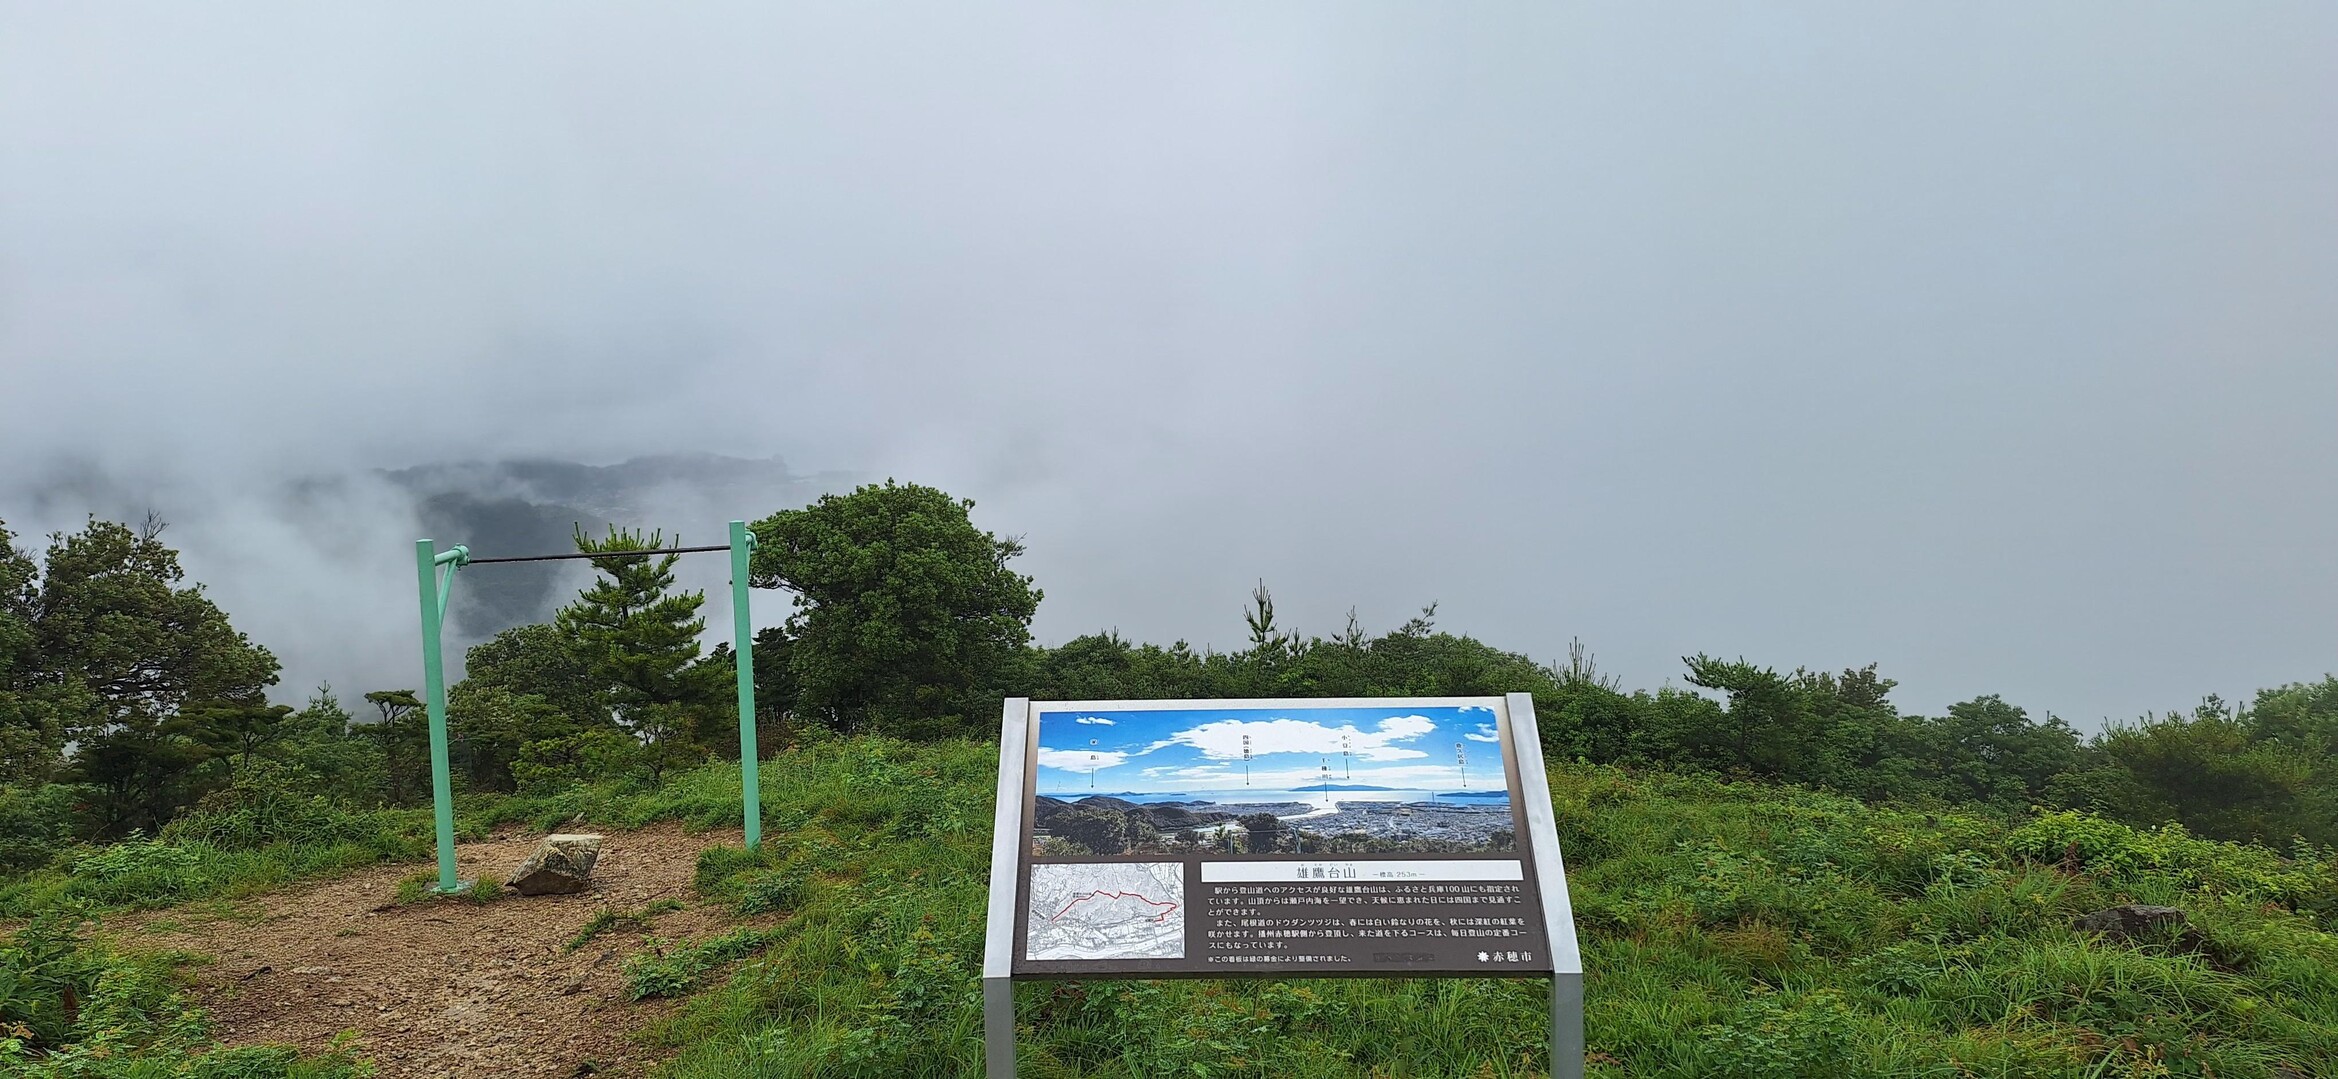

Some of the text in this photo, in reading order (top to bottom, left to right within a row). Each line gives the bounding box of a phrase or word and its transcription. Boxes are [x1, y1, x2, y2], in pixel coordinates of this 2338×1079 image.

[1296, 866, 1356, 879] 雄鷹台山
[1207, 908, 1261, 916] とができます。
[1208, 941, 1289, 950] スにもなっています。
[1492, 950, 1532, 963] 赤穂市
